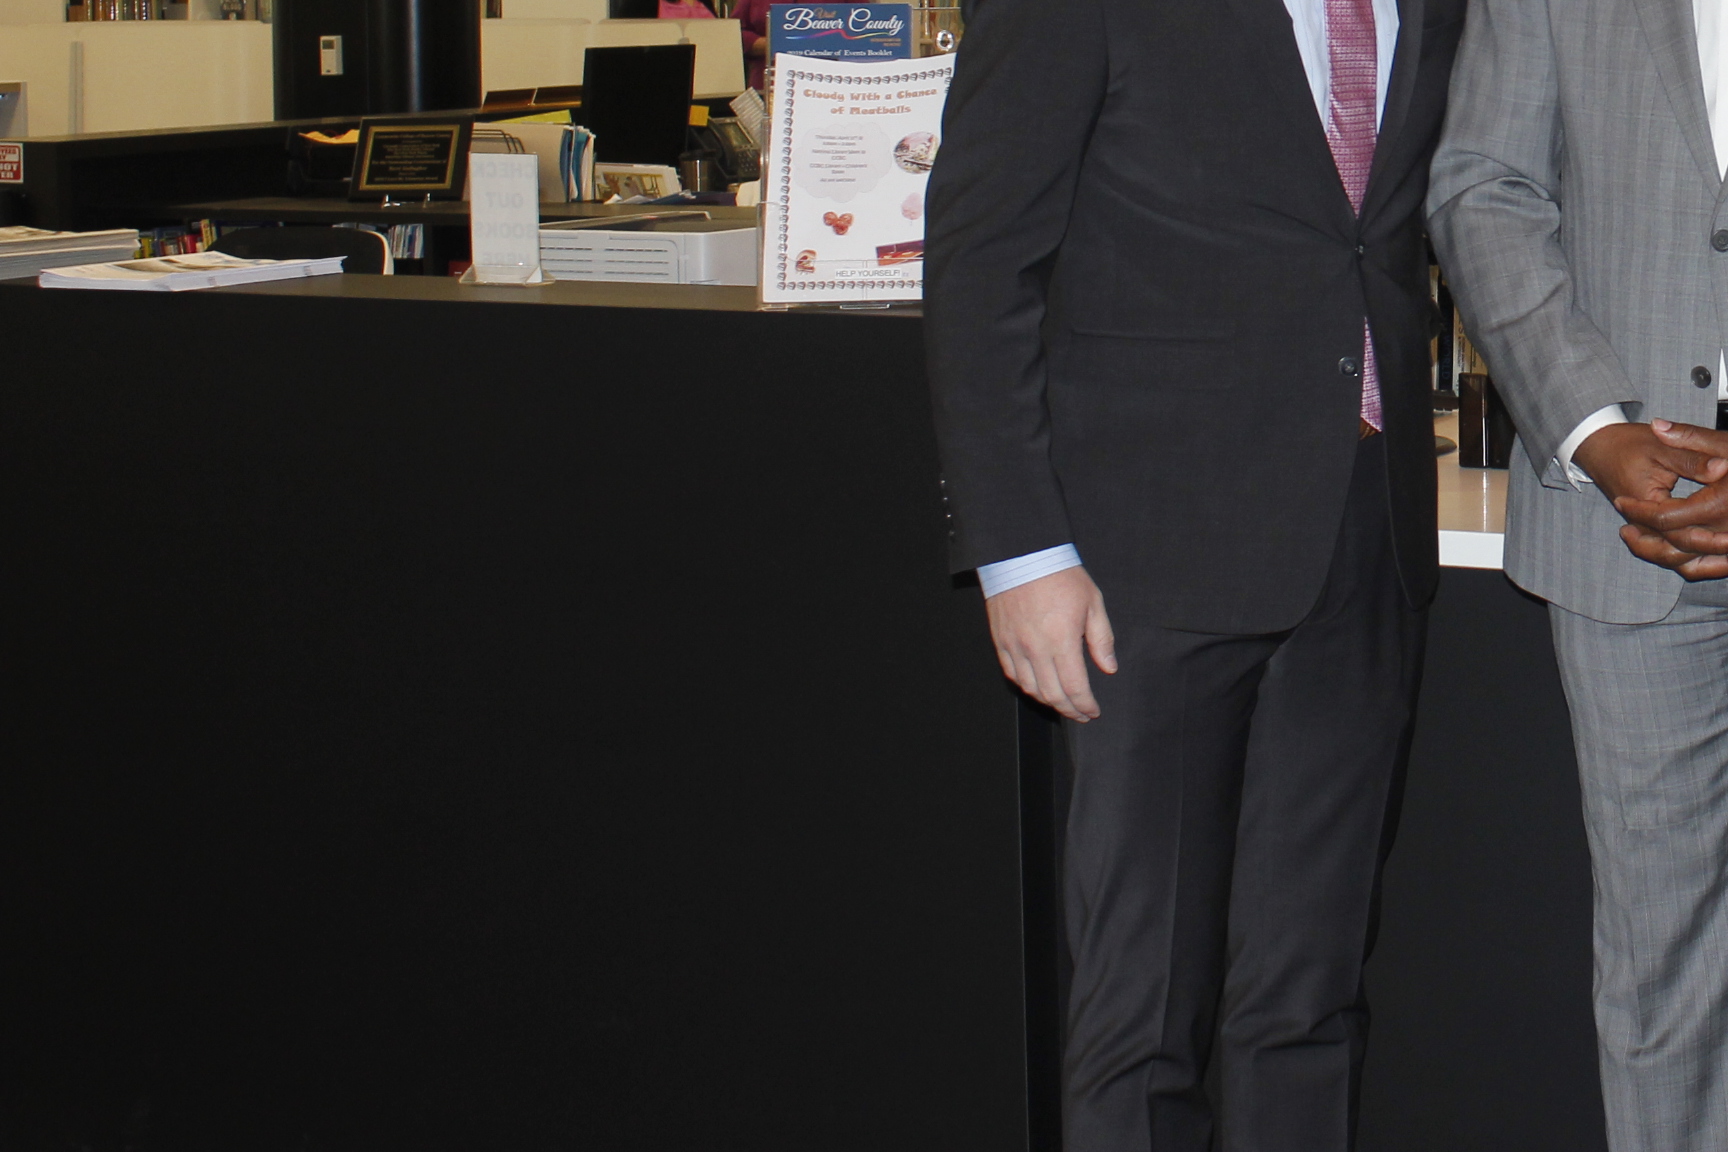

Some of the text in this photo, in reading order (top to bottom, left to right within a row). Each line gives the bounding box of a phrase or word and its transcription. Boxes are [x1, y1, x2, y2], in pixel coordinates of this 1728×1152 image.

[783, 8, 905, 36] Beaver County
[803, 88, 845, 102] Cloudy
[896, 88, 938, 99] Chance
[830, 105, 912, 115] of Meatballs
[857, 269, 901, 277] YOURSELF!
